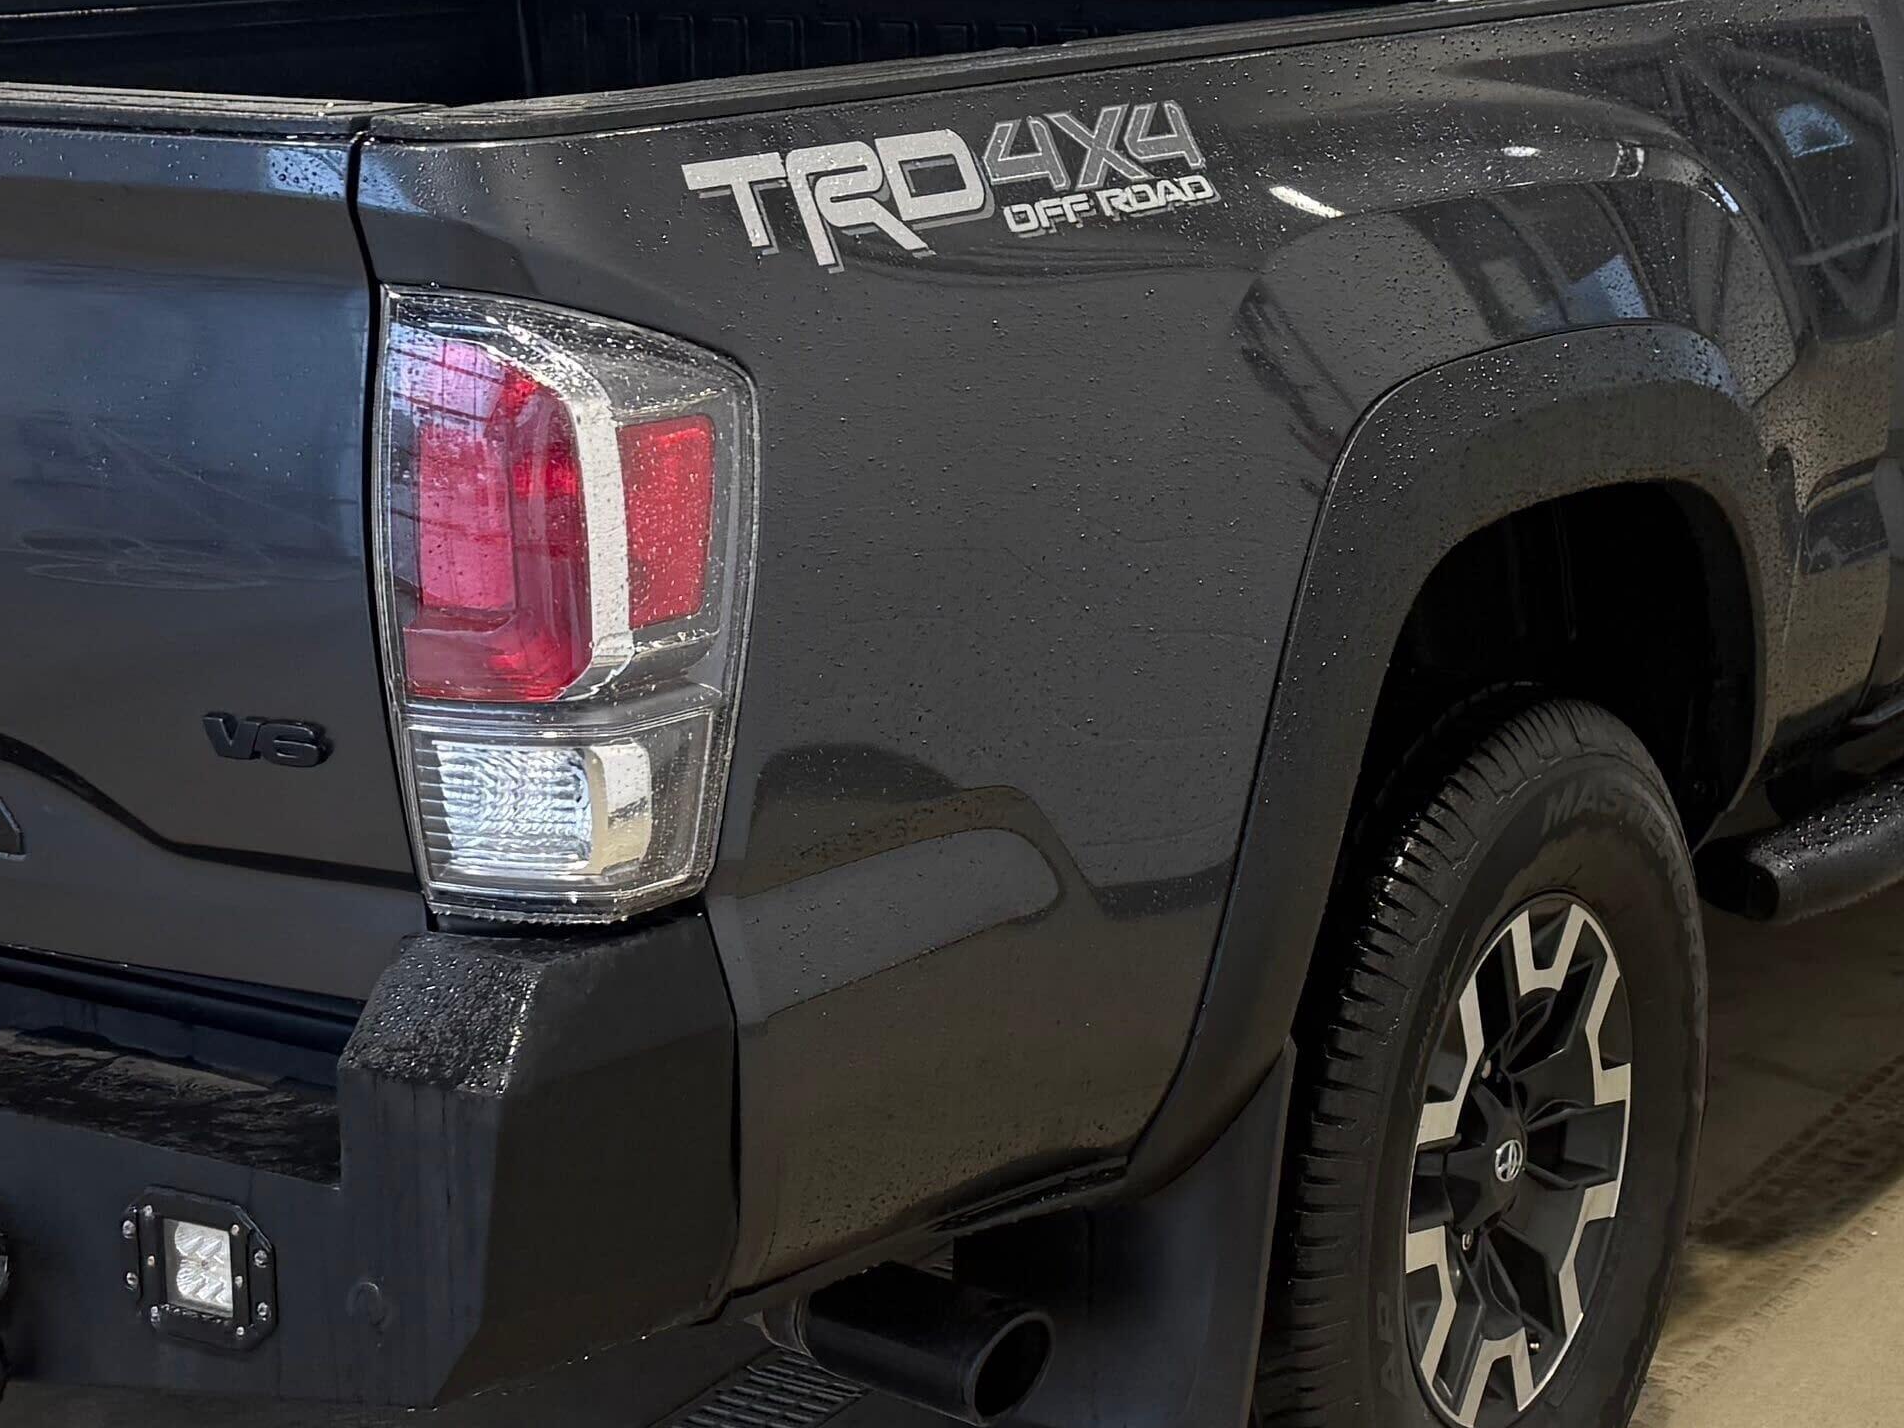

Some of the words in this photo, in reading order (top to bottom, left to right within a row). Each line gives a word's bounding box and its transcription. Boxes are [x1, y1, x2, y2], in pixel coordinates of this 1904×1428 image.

[681, 128, 995, 274] TRD
[1002, 191, 1094, 236] OFF
[1094, 174, 1222, 223] ROAD
[202, 711, 334, 768] V6
